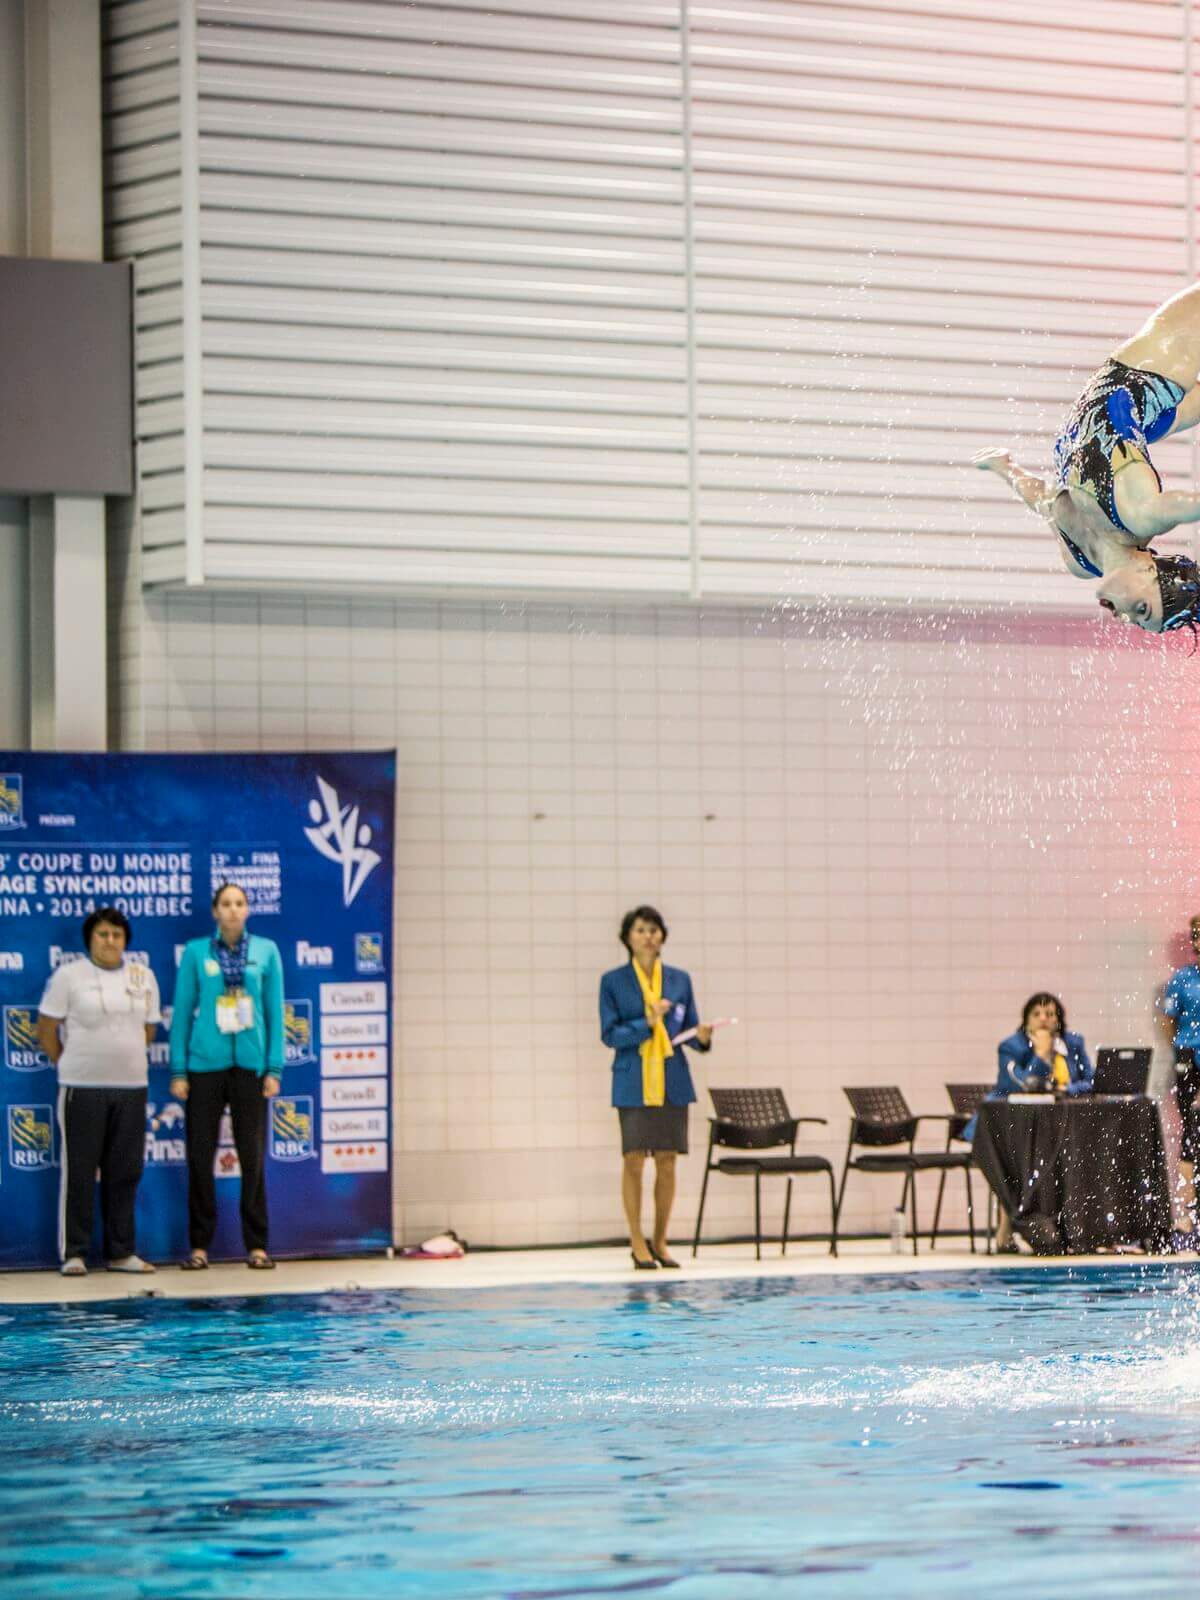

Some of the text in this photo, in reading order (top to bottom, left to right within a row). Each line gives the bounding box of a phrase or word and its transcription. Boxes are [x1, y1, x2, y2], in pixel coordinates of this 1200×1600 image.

[0, 811, 20, 825] BC
[18, 852, 83, 872] COUPE
[90, 853, 117, 872] DU
[124, 852, 192, 873] MONDE
[0, 870, 192, 894] AGE SYNCHRONISÉE
[0, 897, 31, 916] INA
[50, 897, 96, 917] 2014
[114, 894, 192, 917] QUÉBEC
[14, 1150, 50, 1166] RBC
